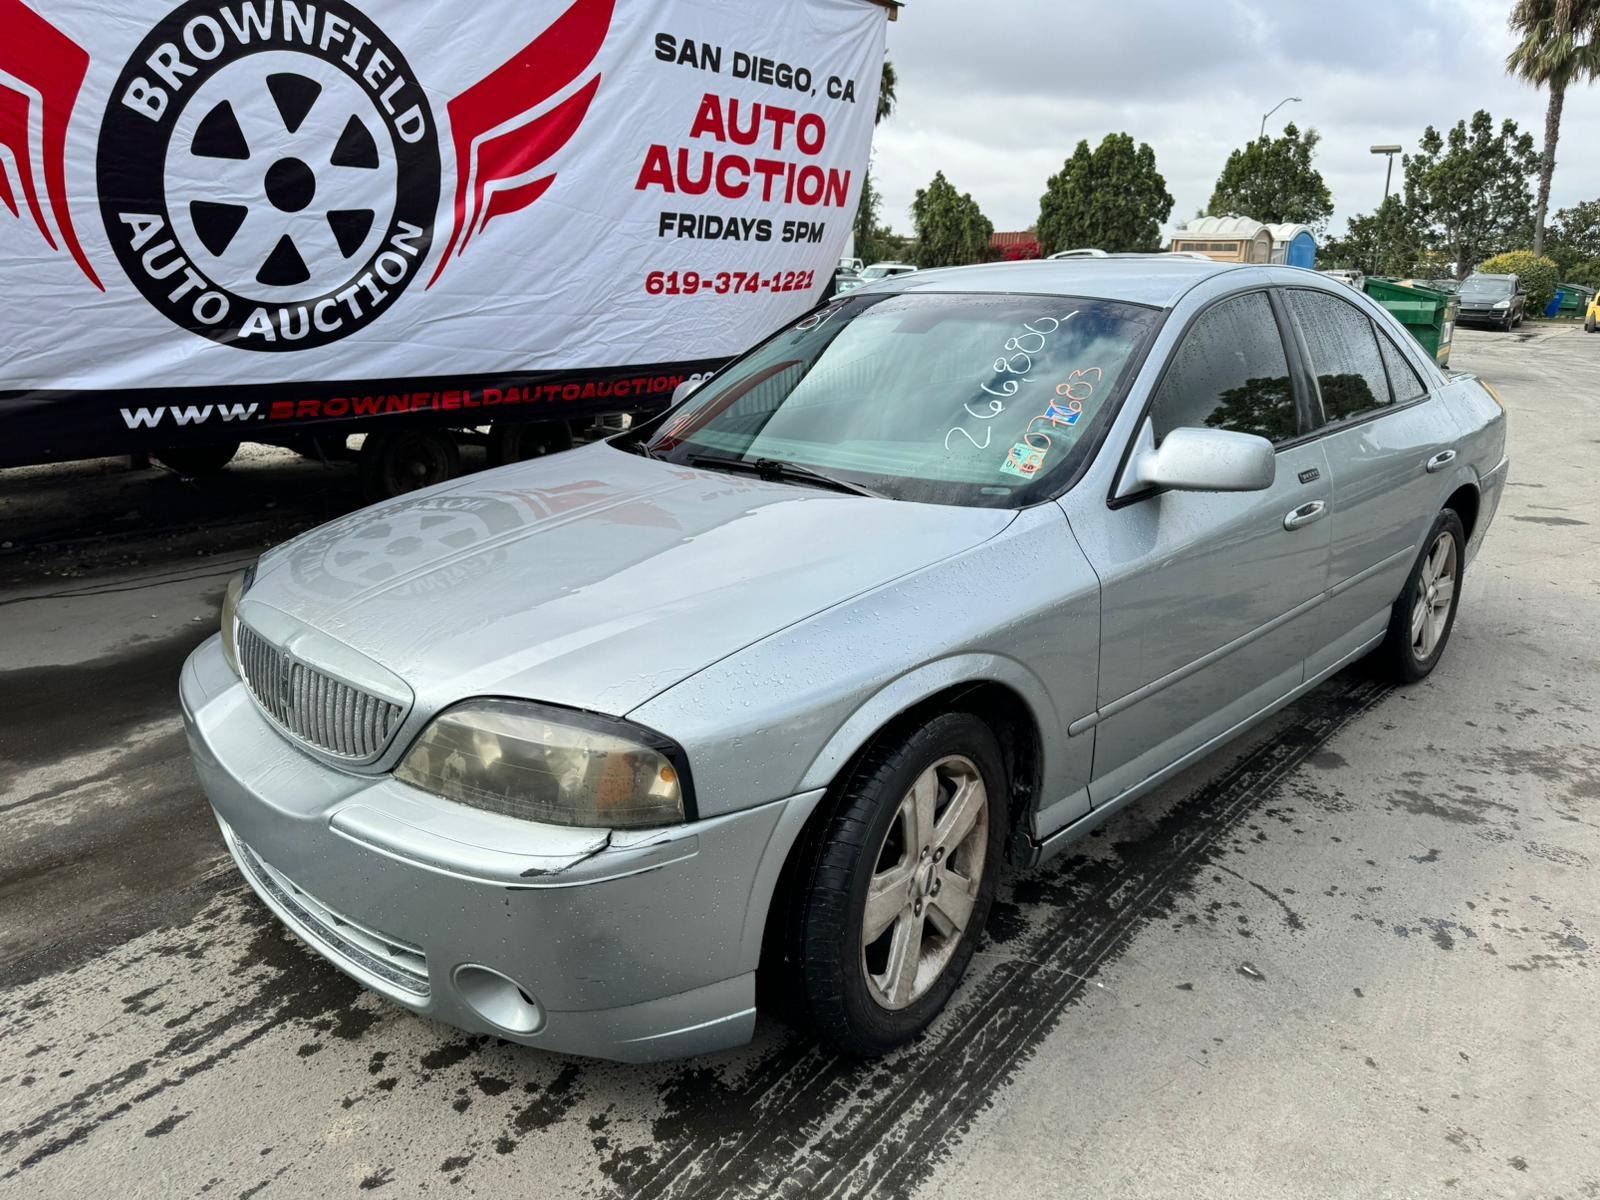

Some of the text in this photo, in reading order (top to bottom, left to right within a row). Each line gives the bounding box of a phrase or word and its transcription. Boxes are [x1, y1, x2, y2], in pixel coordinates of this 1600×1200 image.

[121, 0, 426, 143] BROWNFIELD
[654, 32, 856, 103] SAN DIEGO, CA
[689, 92, 826, 155] AUTO
[634, 143, 851, 208] AUCTION
[658, 211, 826, 243] FRIDAYS 5PM
[118, 211, 424, 341] AUTO AUCTION
[644, 269, 815, 295] 619-374-1221
